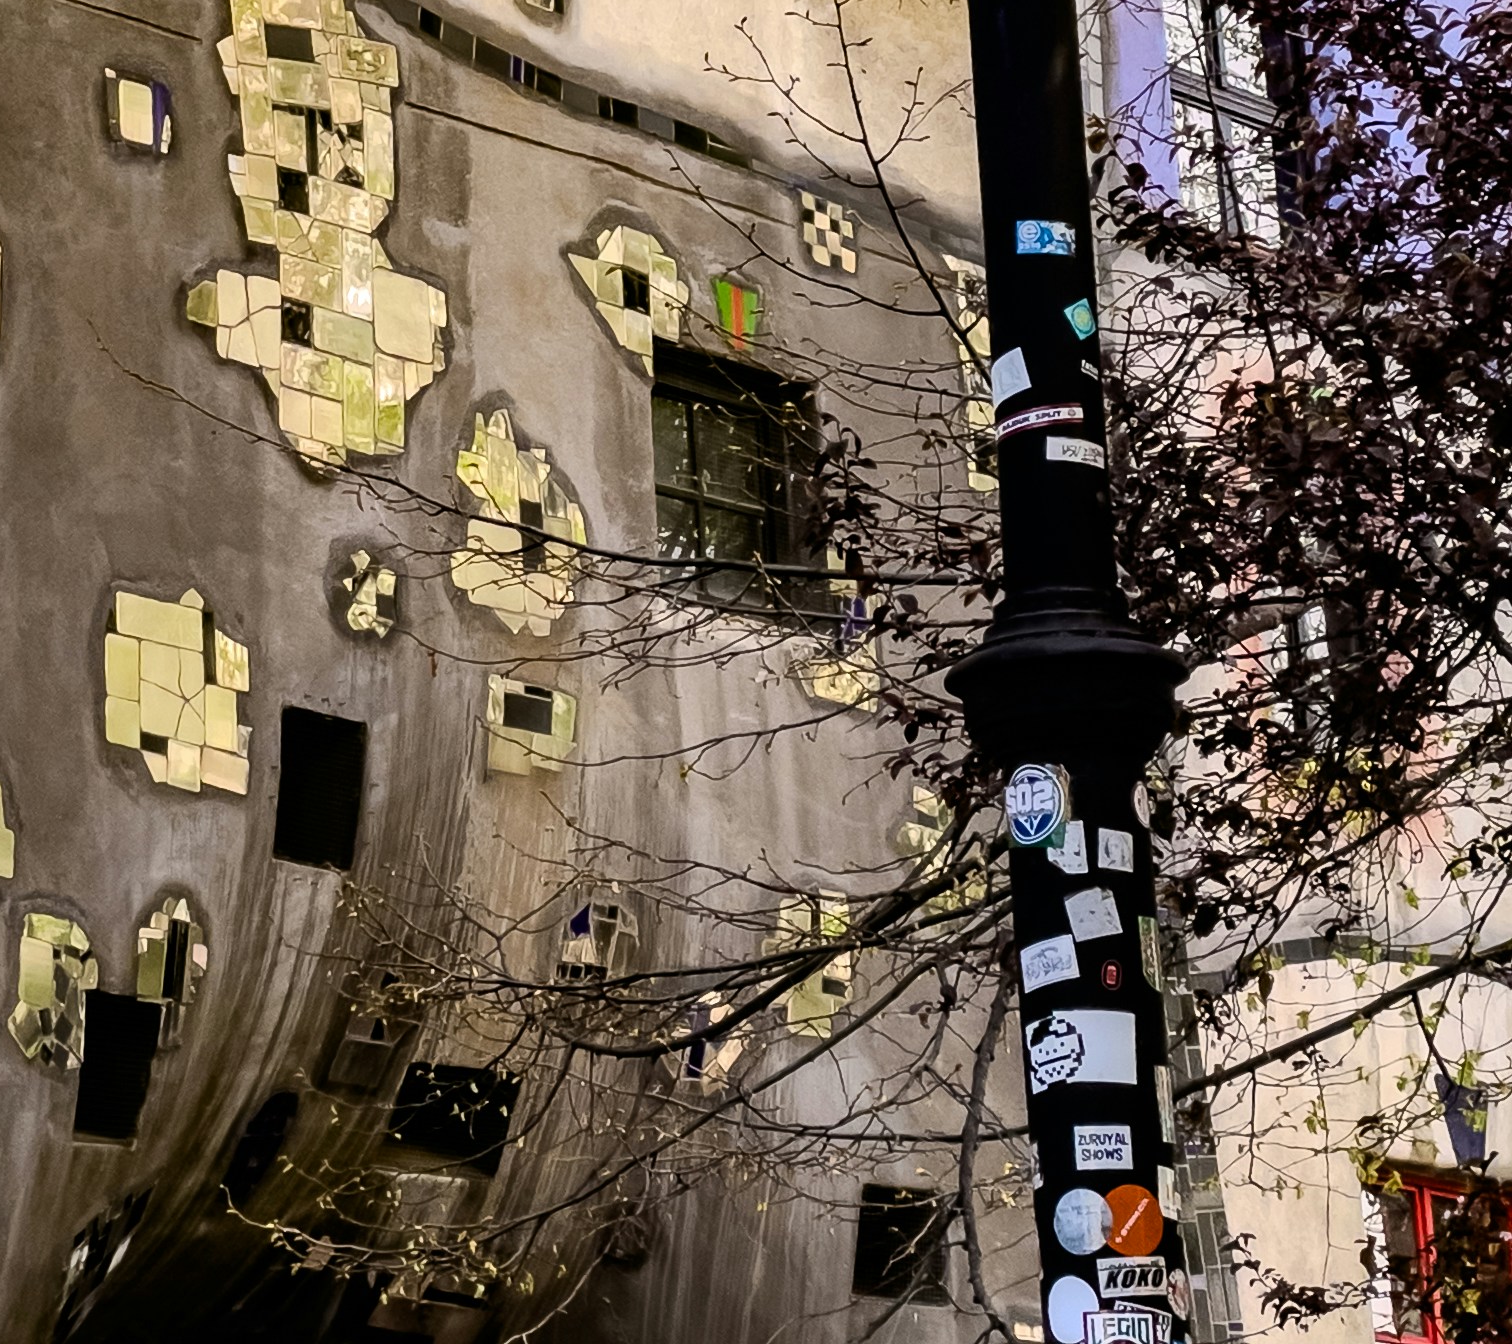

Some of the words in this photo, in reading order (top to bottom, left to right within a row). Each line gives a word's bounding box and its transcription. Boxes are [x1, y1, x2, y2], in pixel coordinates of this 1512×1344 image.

[1035, 410, 1062, 421] SPLIT
[1081, 1148, 1124, 1162] SHOWS
[1104, 1267, 1165, 1289] KOKO
